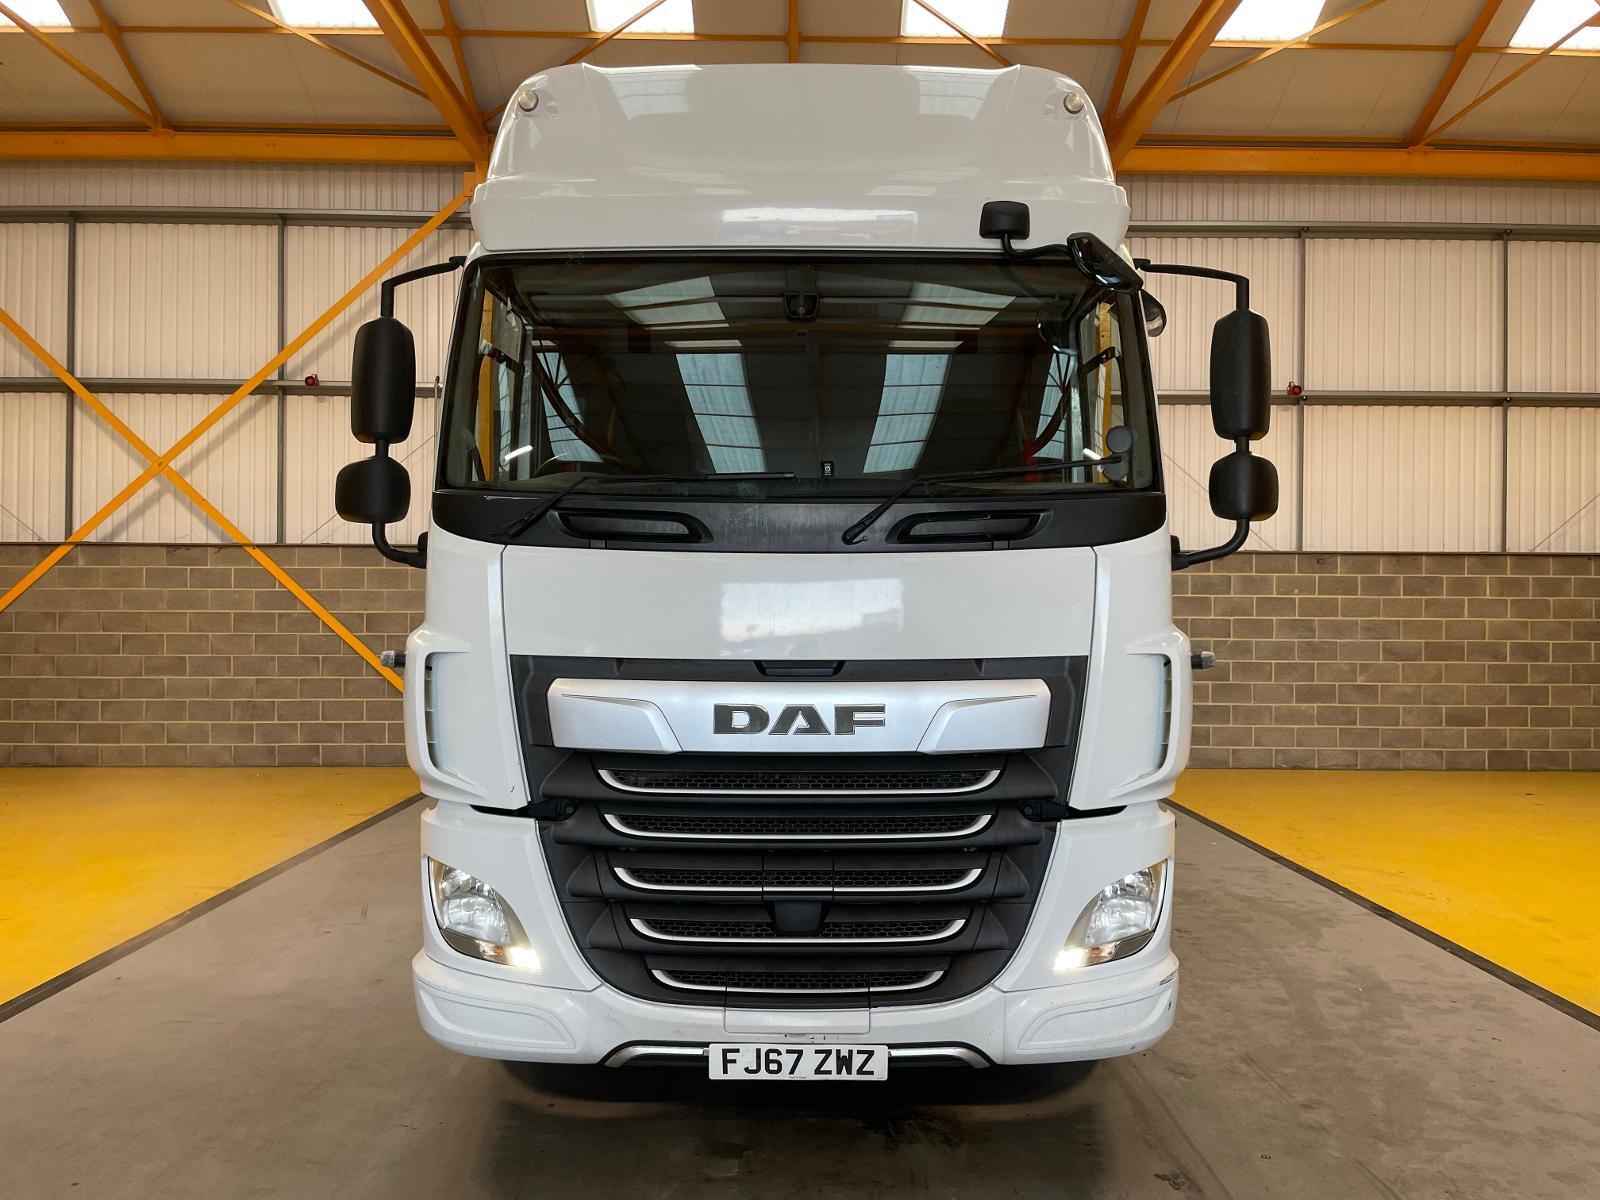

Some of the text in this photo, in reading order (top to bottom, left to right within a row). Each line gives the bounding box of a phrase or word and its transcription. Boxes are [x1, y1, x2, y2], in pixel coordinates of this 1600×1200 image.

[713, 704, 886, 735] DAF
[721, 1048, 875, 1076] FJ67 ZWZ
